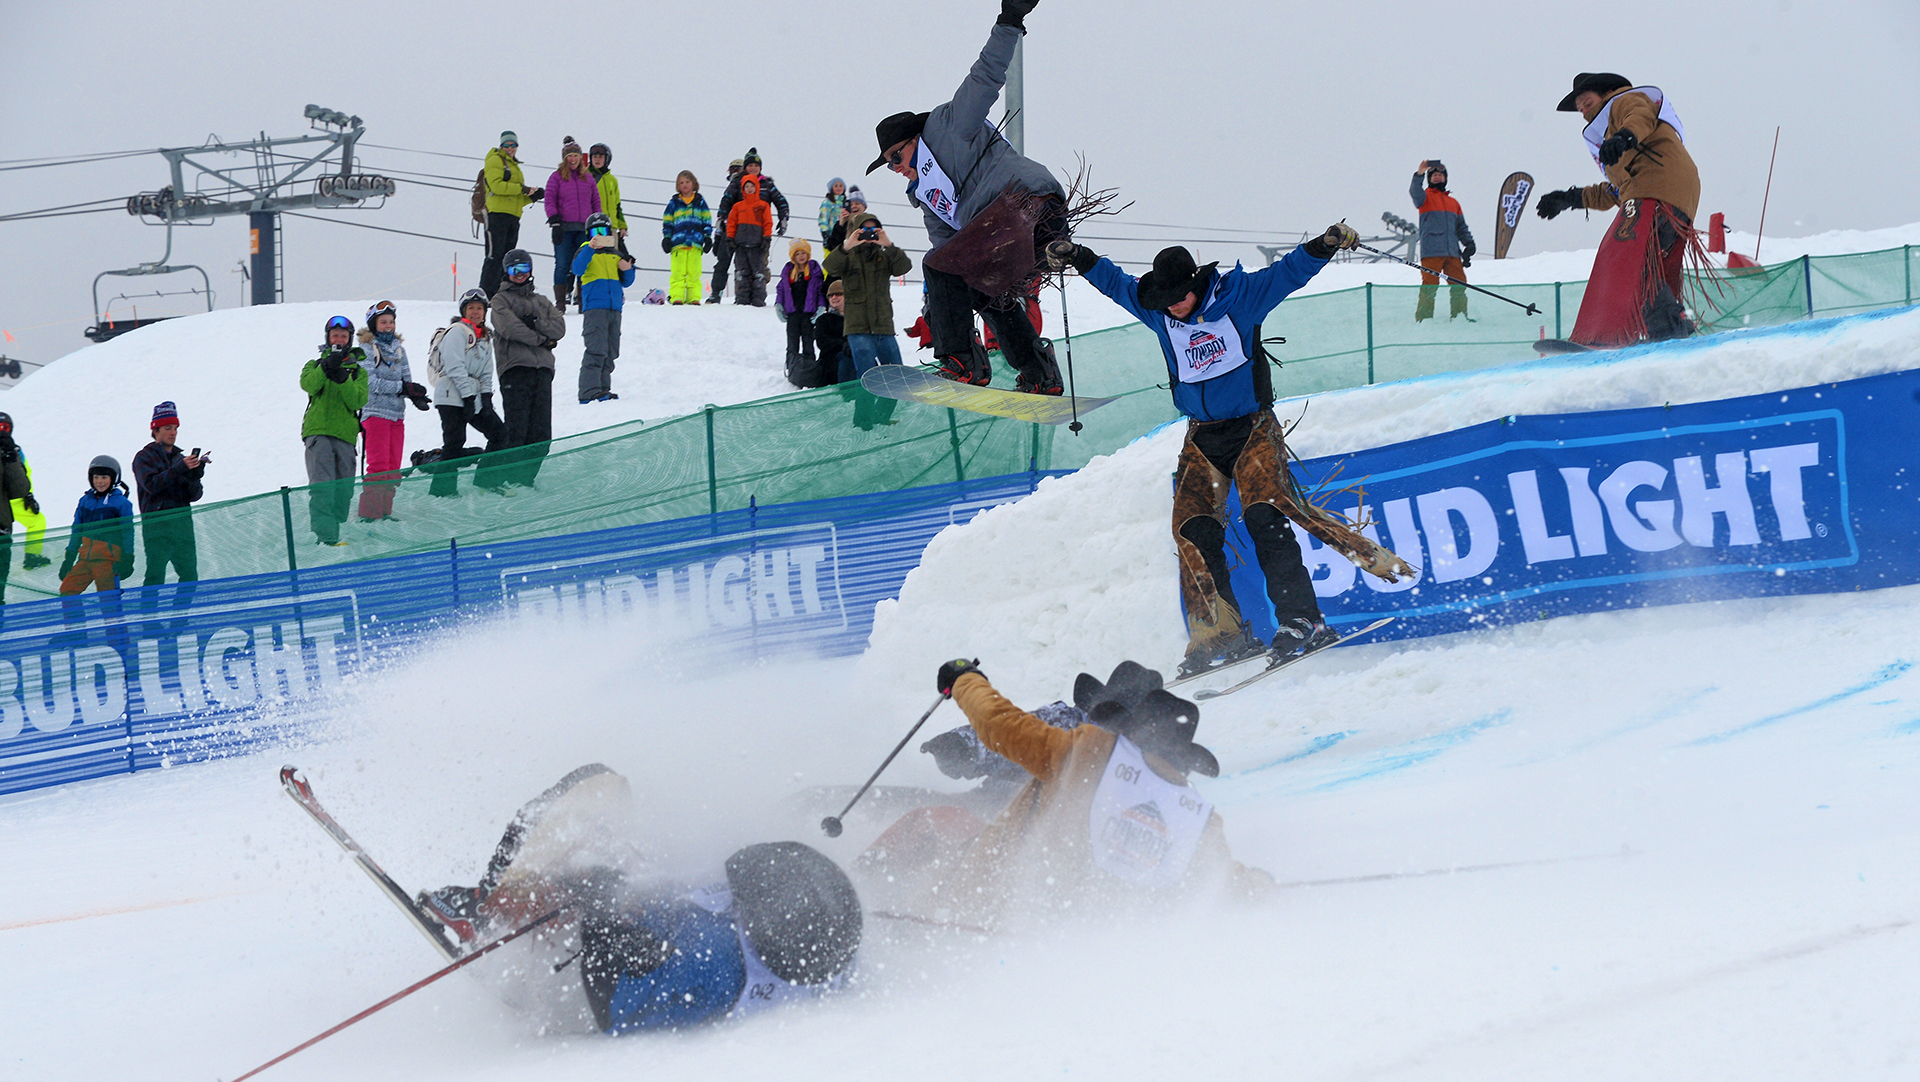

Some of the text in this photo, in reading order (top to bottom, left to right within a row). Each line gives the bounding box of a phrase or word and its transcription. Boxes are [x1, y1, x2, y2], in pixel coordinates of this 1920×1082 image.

[1185, 336, 1227, 369] COWBOY
[1287, 442, 1819, 598] BUD LIGHT
[656, 545, 826, 632] LIGHT
[136, 614, 346, 715] LIGHT
[1114, 763, 1142, 785] 061
[1179, 794, 1204, 816] 061
[750, 983, 776, 1001] 042
